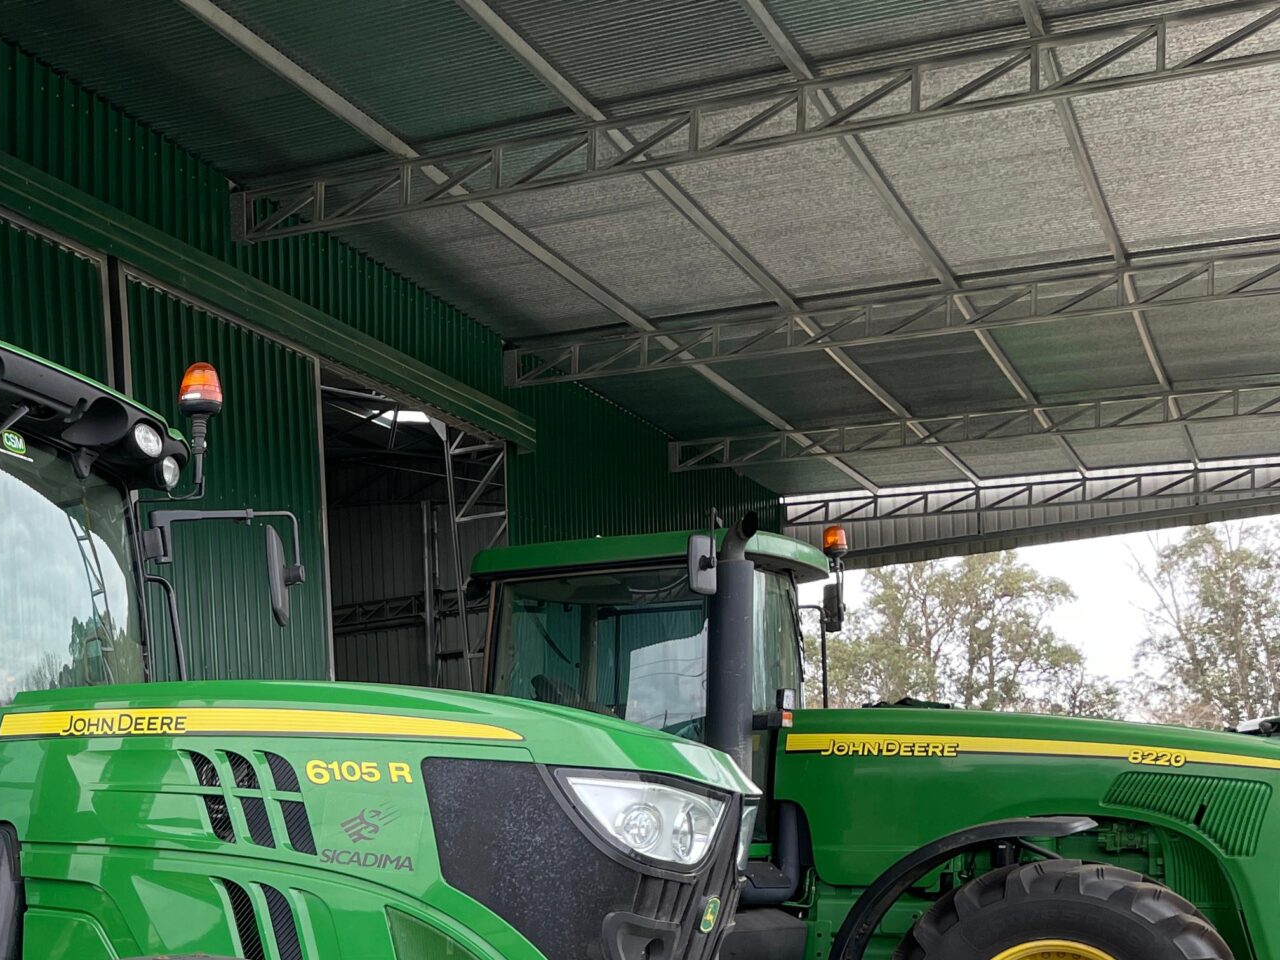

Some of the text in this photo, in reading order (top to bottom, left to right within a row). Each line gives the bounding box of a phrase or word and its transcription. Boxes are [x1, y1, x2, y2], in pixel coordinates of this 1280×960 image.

[62, 714, 187, 732] JOHN DEERE
[820, 739, 959, 757] JOHN DEERE
[1128, 749, 1186, 767] 8220
[305, 759, 413, 784] 6105 R
[320, 848, 414, 871] SICADIMA
